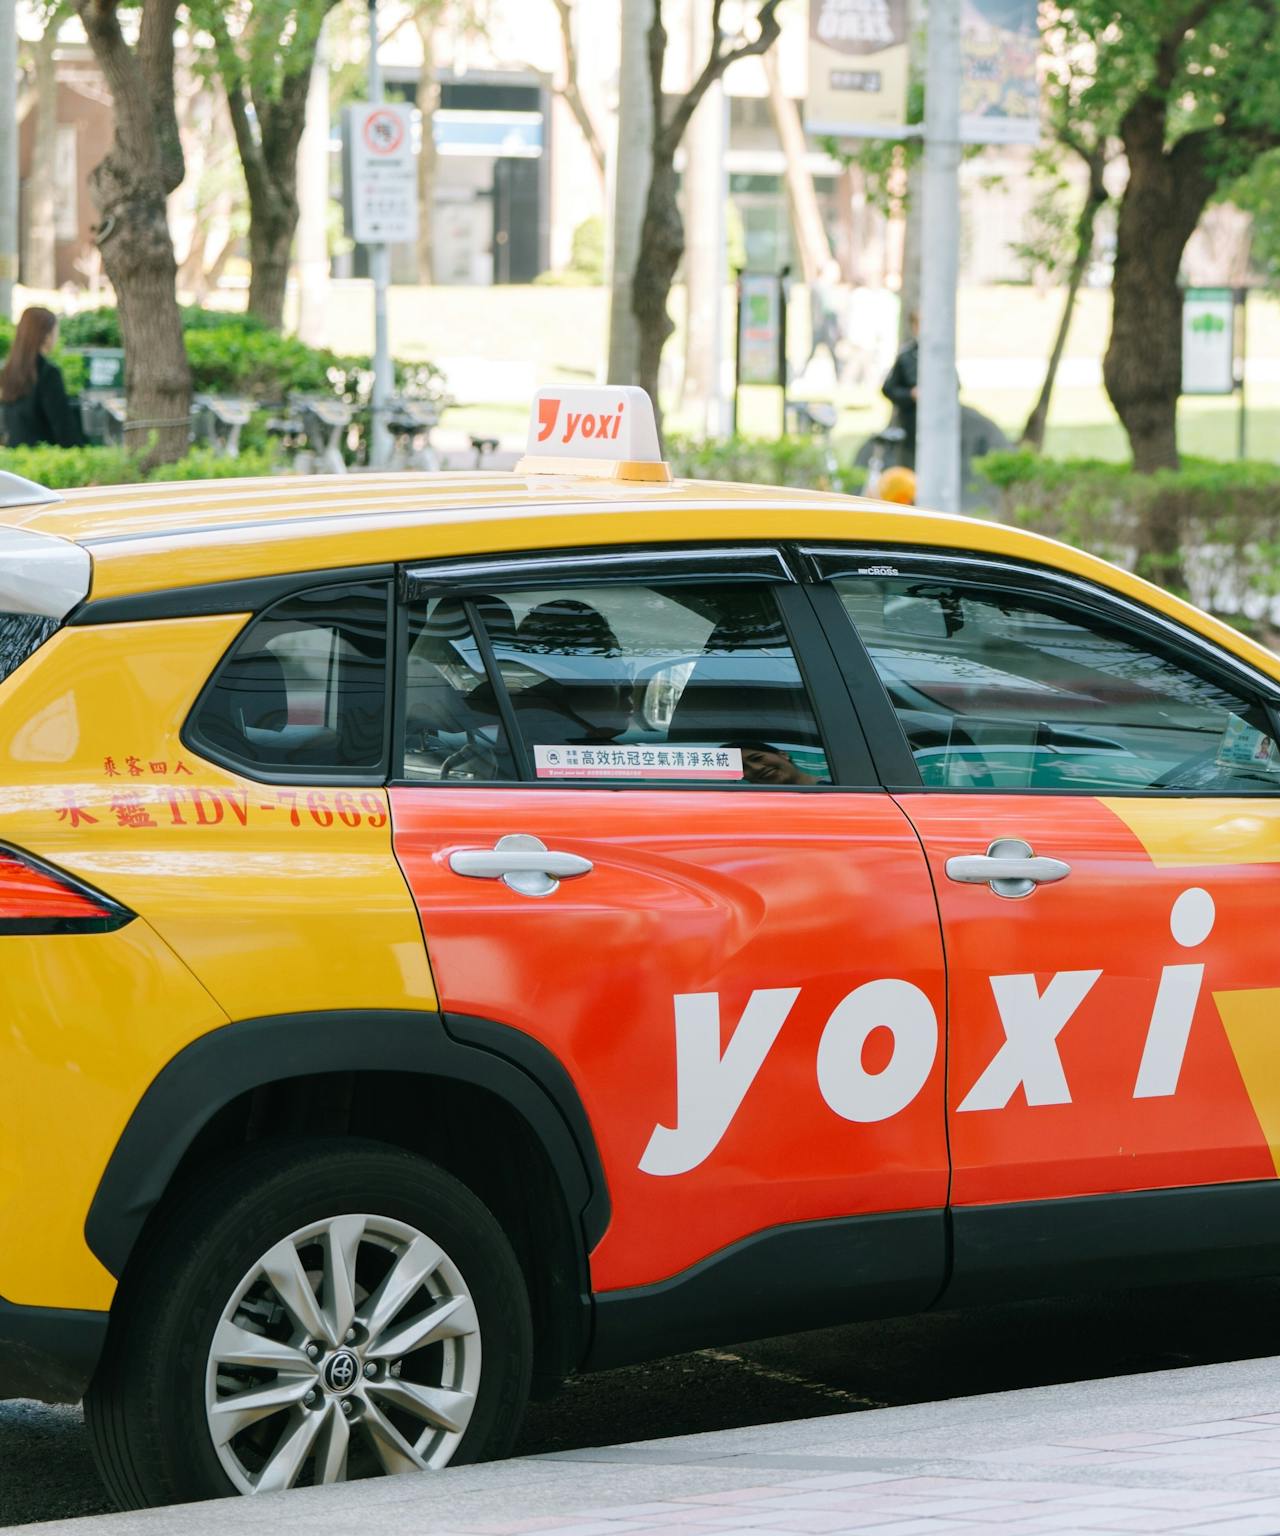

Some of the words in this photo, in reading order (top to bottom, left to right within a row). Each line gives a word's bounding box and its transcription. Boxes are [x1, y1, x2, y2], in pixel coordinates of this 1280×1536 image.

[562, 402, 624, 443] yoxi
[867, 568, 899, 576] CROSS
[103, 756, 193, 777] 乘客四人
[581, 750, 730, 767] 高效抗冠空氣清淨系統
[157, 786, 387, 828] TDV-7669
[637, 887, 1215, 1176] yoxi
